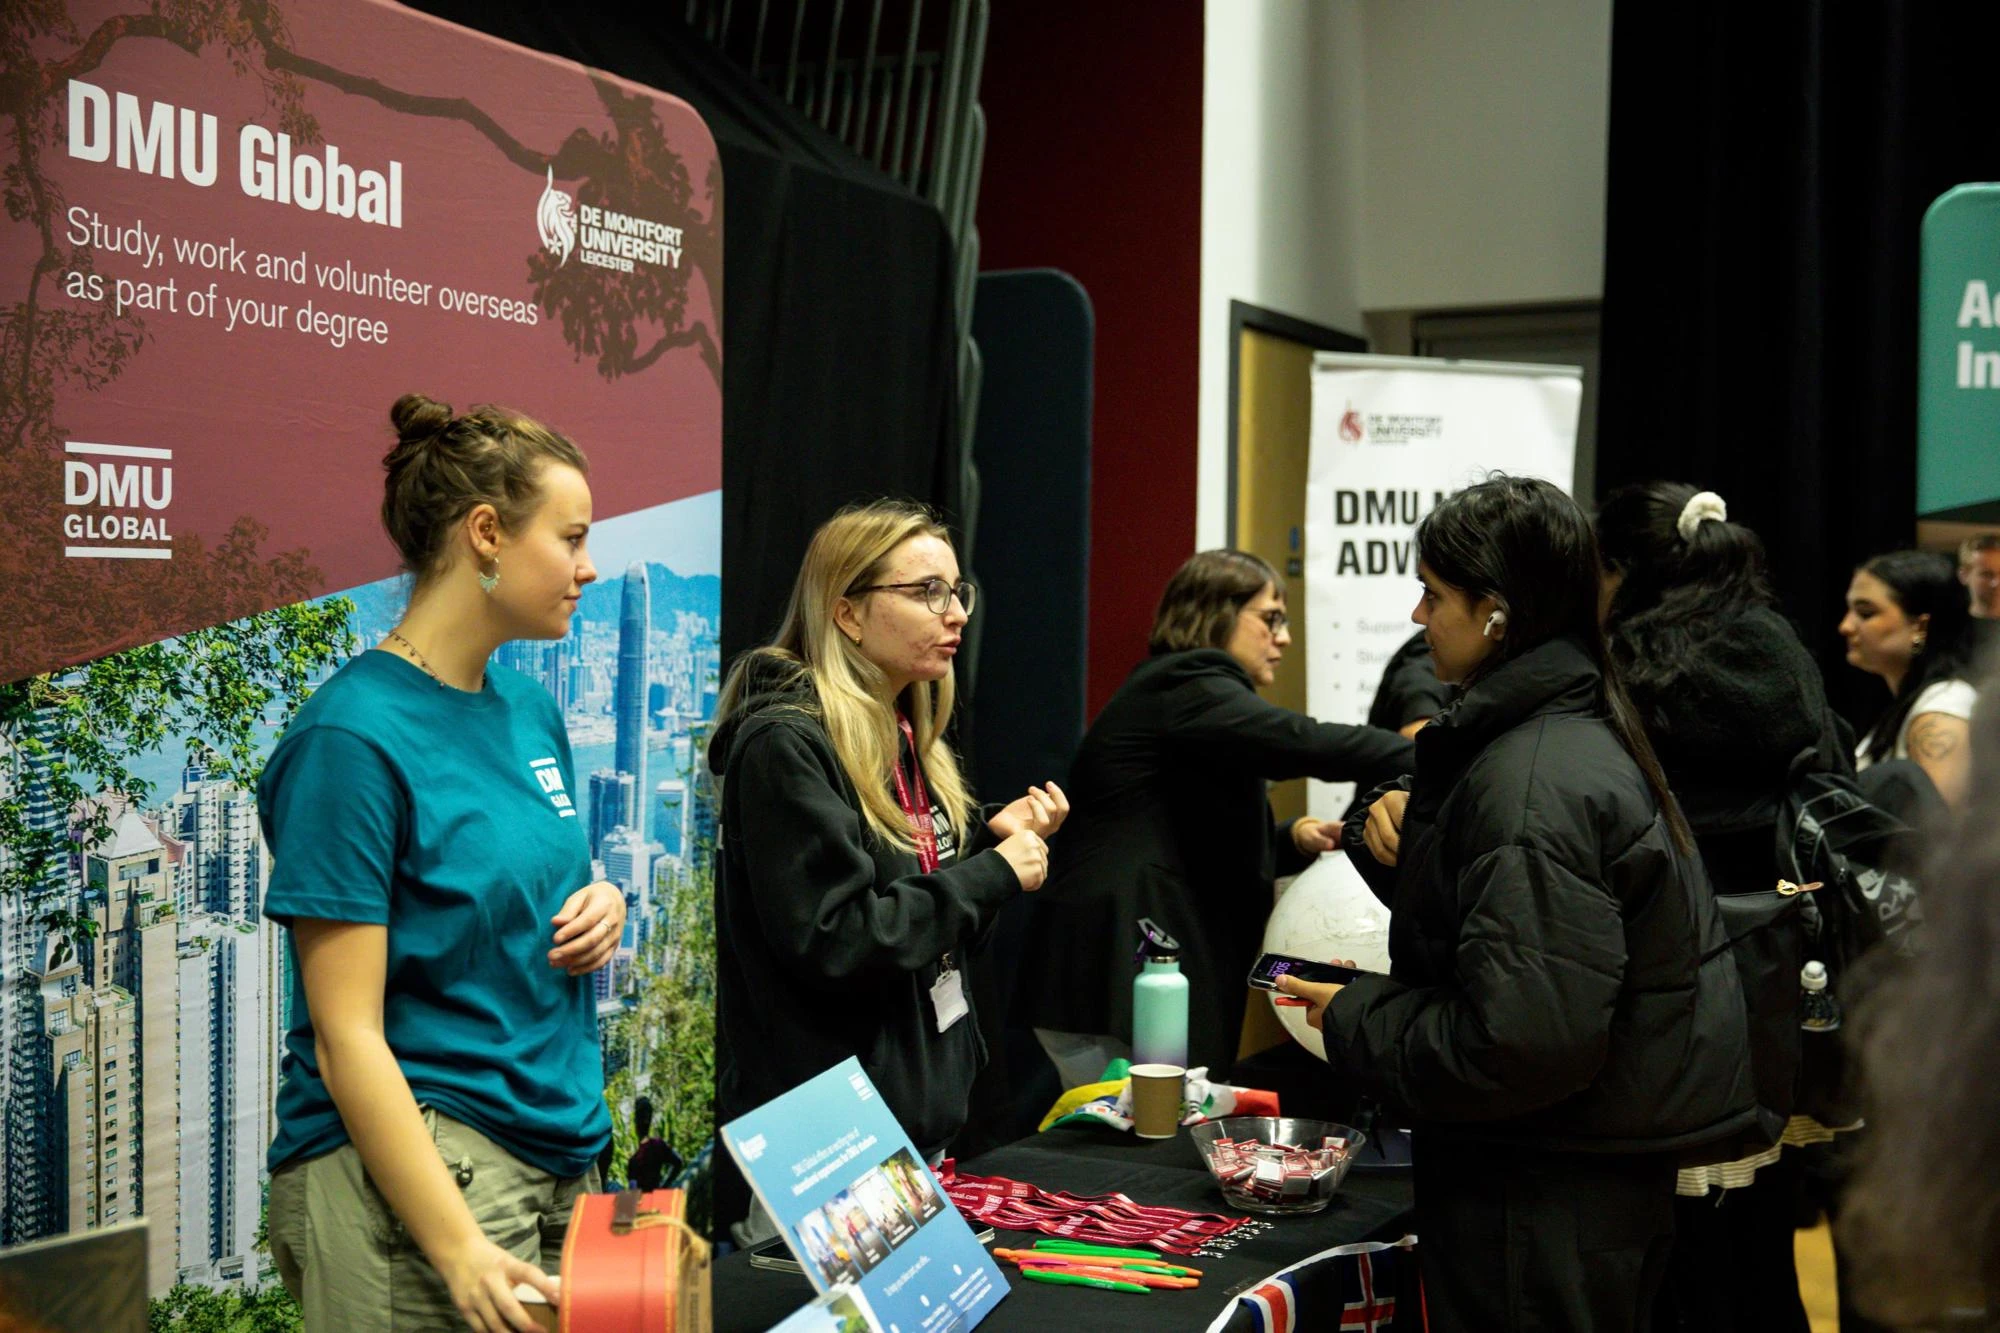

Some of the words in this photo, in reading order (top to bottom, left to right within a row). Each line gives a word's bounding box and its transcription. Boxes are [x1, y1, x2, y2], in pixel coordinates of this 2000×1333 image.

[68, 79, 218, 187] DMU
[239, 124, 403, 229] Global
[580, 204, 602, 226] DE
[604, 210, 683, 246] MONTFORT
[580, 224, 683, 269] UNIVERSITY
[67, 207, 164, 268] Study,
[174, 238, 247, 275] work
[256, 252, 307, 285] and
[315, 260, 432, 306] volunteer
[439, 287, 538, 326] overseas
[580, 249, 634, 273] LEICESTER
[66, 272, 104, 301] as
[117, 278, 177, 316] part
[187, 283, 217, 318] of
[226, 296, 288, 331] your
[296, 300, 389, 348] degree
[1957, 279, 2000, 329] A
[65, 461, 173, 510] DMU
[1335, 489, 1419, 526] DMU
[64, 514, 172, 541] GLOBAL
